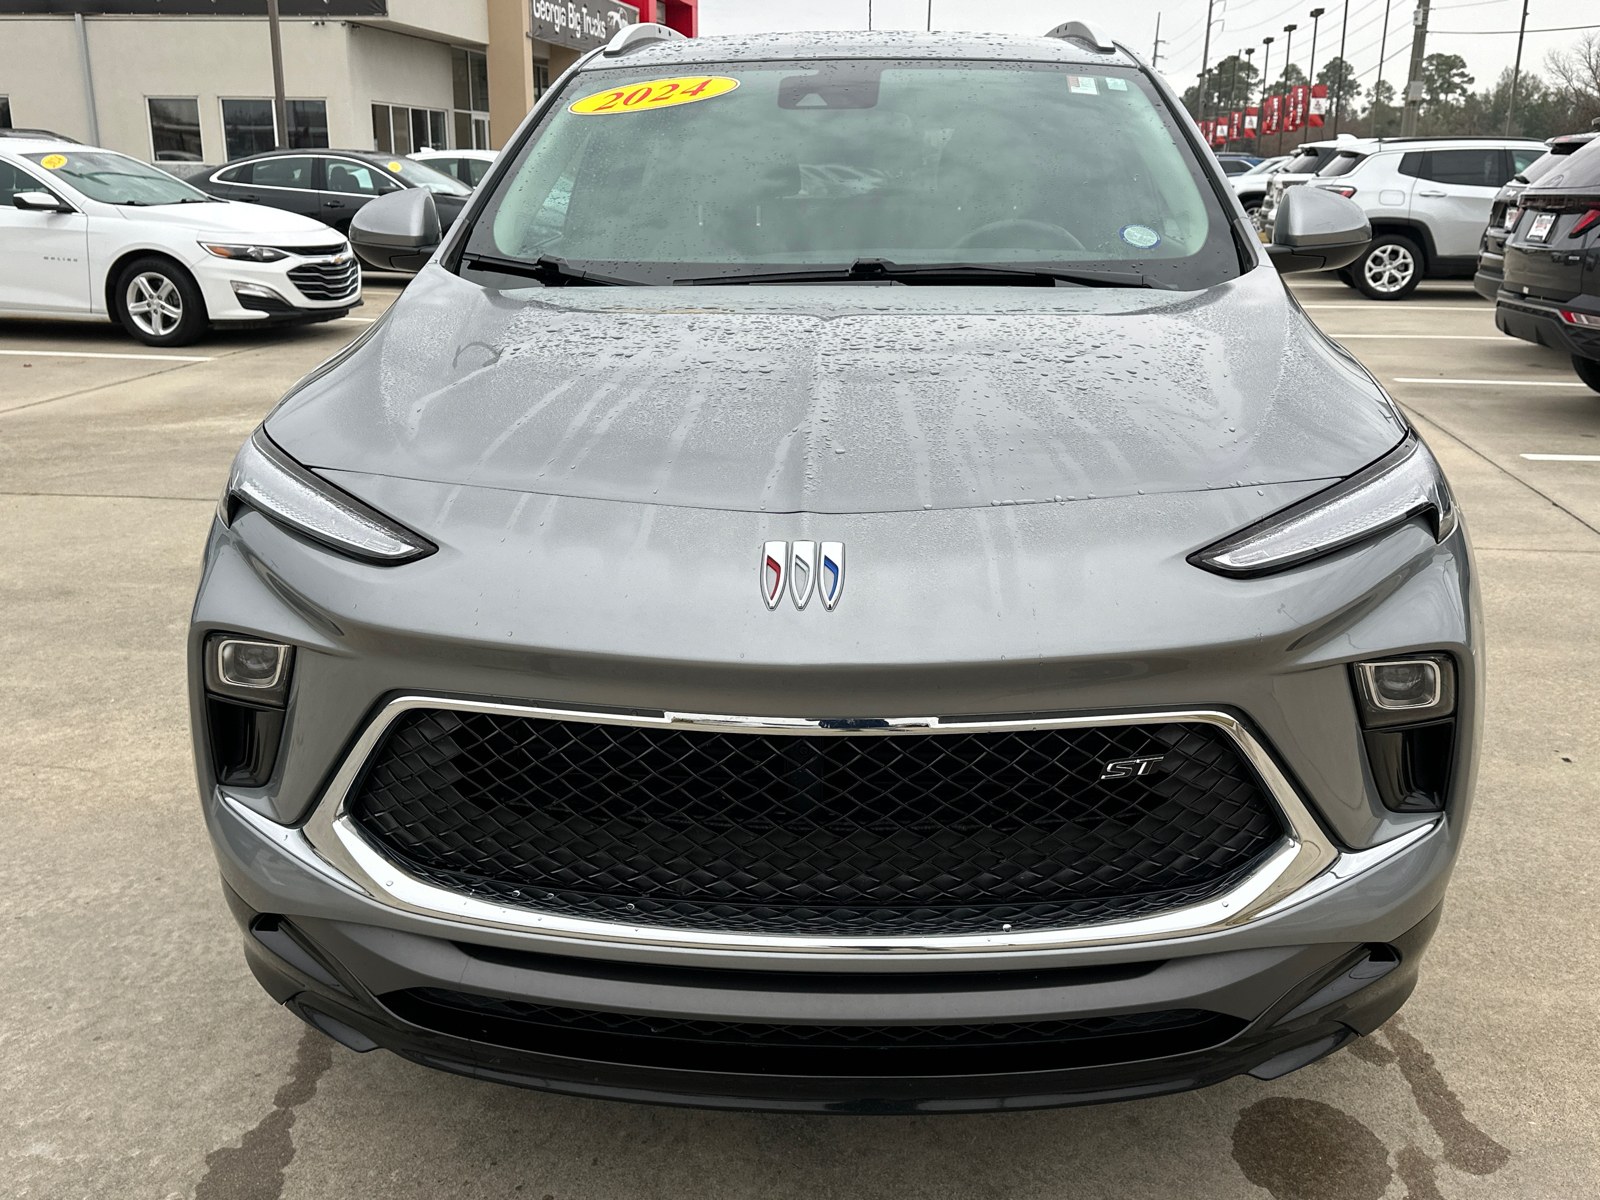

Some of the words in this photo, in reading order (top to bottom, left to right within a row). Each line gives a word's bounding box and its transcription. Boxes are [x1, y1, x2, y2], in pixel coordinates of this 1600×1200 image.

[533, 0, 566, 32] Georgia
[568, 3, 580, 38] Big
[582, 7, 606, 39] Trucks
[592, 79, 713, 111] 2024
[1101, 756, 1164, 779] ST
